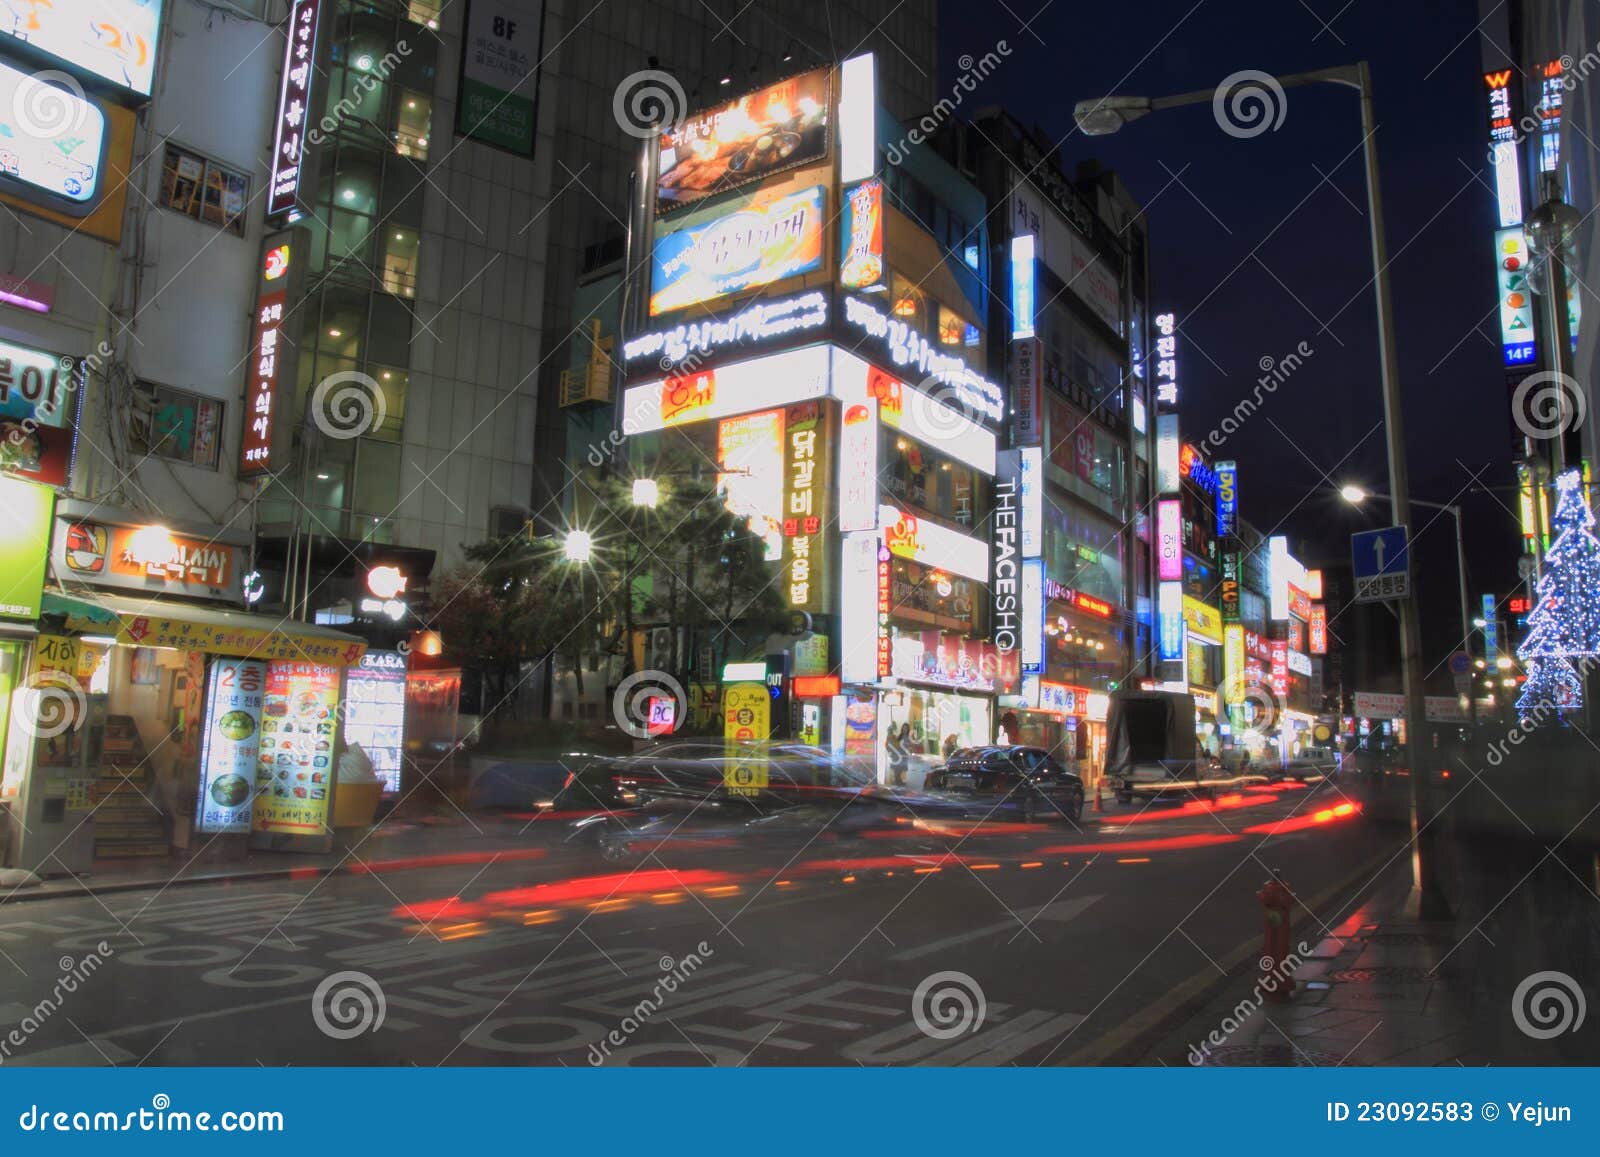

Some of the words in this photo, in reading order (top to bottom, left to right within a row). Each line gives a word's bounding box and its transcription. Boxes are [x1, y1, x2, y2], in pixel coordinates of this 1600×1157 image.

[492, 16, 517, 41] 8F
[1484, 70, 1512, 88] W
[1490, 87, 1511, 119] 치과
[1505, 347, 1533, 362] 14F
[791, 430, 816, 516] 닭갈비
[1217, 472, 1235, 503] DVD
[791, 536, 811, 605] 볶음밥
[1358, 575, 1406, 598] 일방통행
[39, 639, 76, 661] 지하
[221, 665, 263, 692] 2층
[767, 673, 783, 686] OUT
[650, 702, 673, 725] PC
